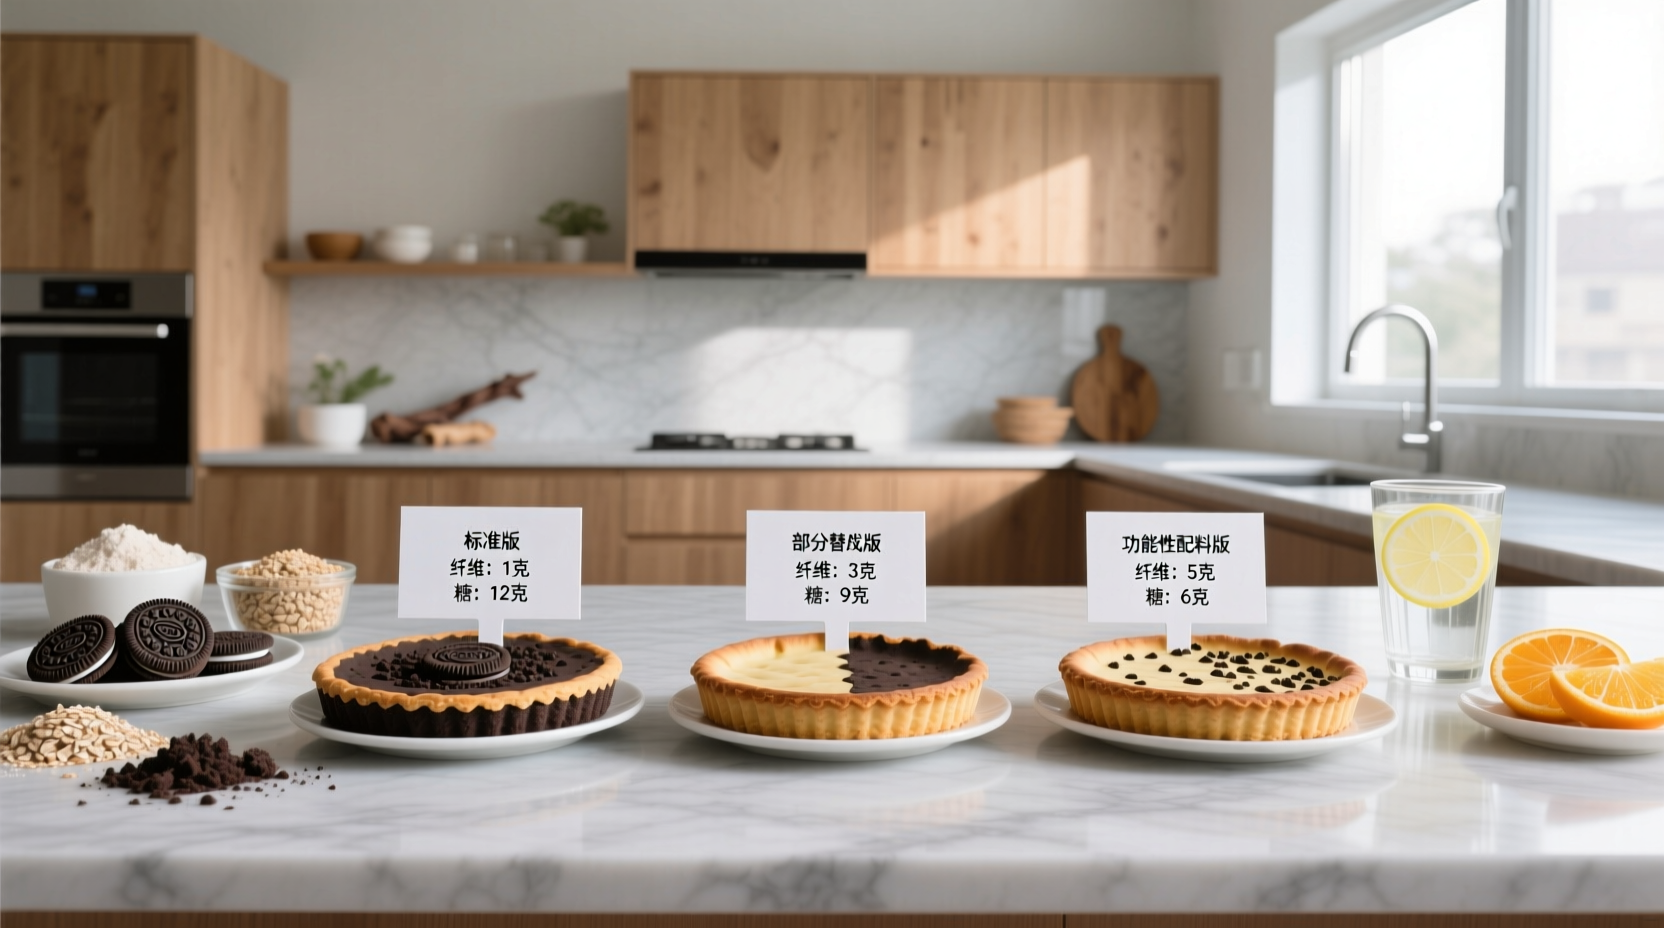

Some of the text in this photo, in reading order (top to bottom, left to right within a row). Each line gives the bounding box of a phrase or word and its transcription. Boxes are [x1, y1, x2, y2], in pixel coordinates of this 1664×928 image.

[463, 530, 520, 551] 标准版
[1121, 533, 1230, 555] 功能性配料版
